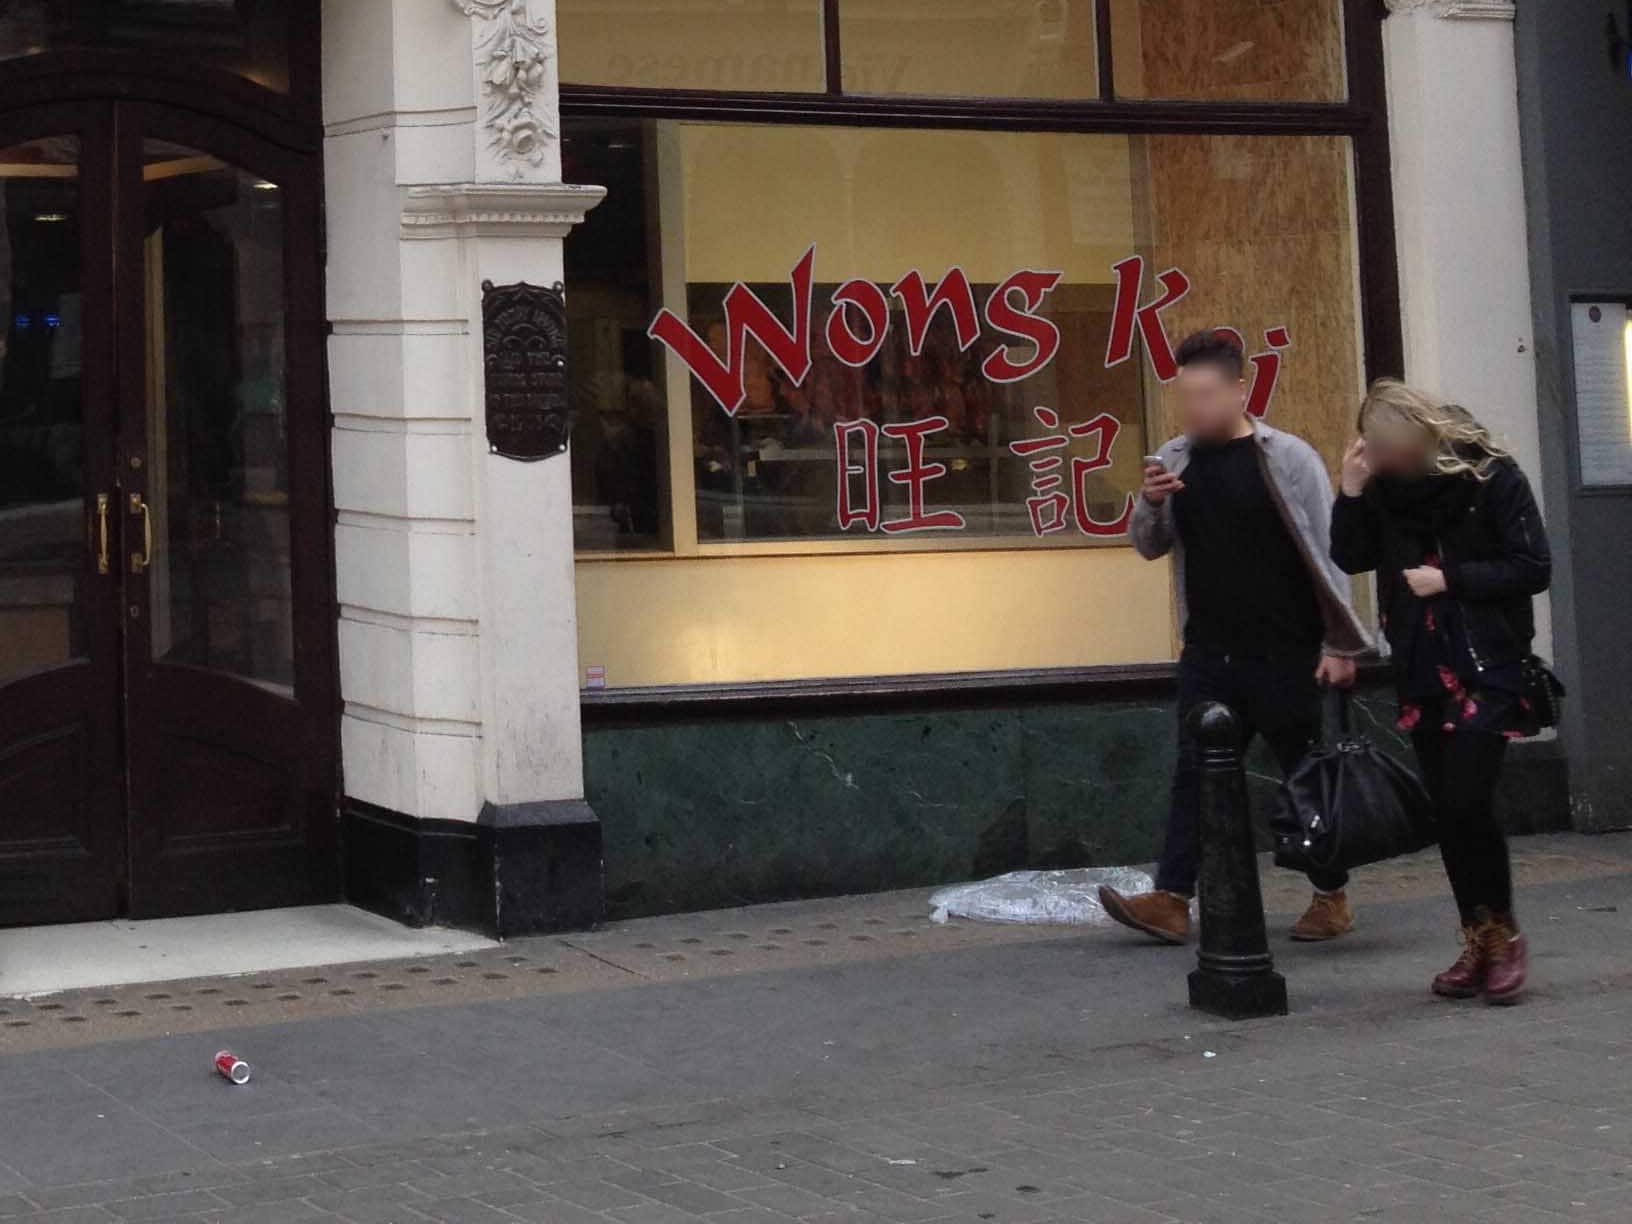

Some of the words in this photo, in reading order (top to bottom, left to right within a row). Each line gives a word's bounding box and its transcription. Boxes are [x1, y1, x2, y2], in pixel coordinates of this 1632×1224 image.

[649, 243, 1062, 416] Wong
[1105, 255, 1290, 418] Ki
[835, 406, 1135, 537] 旺記
